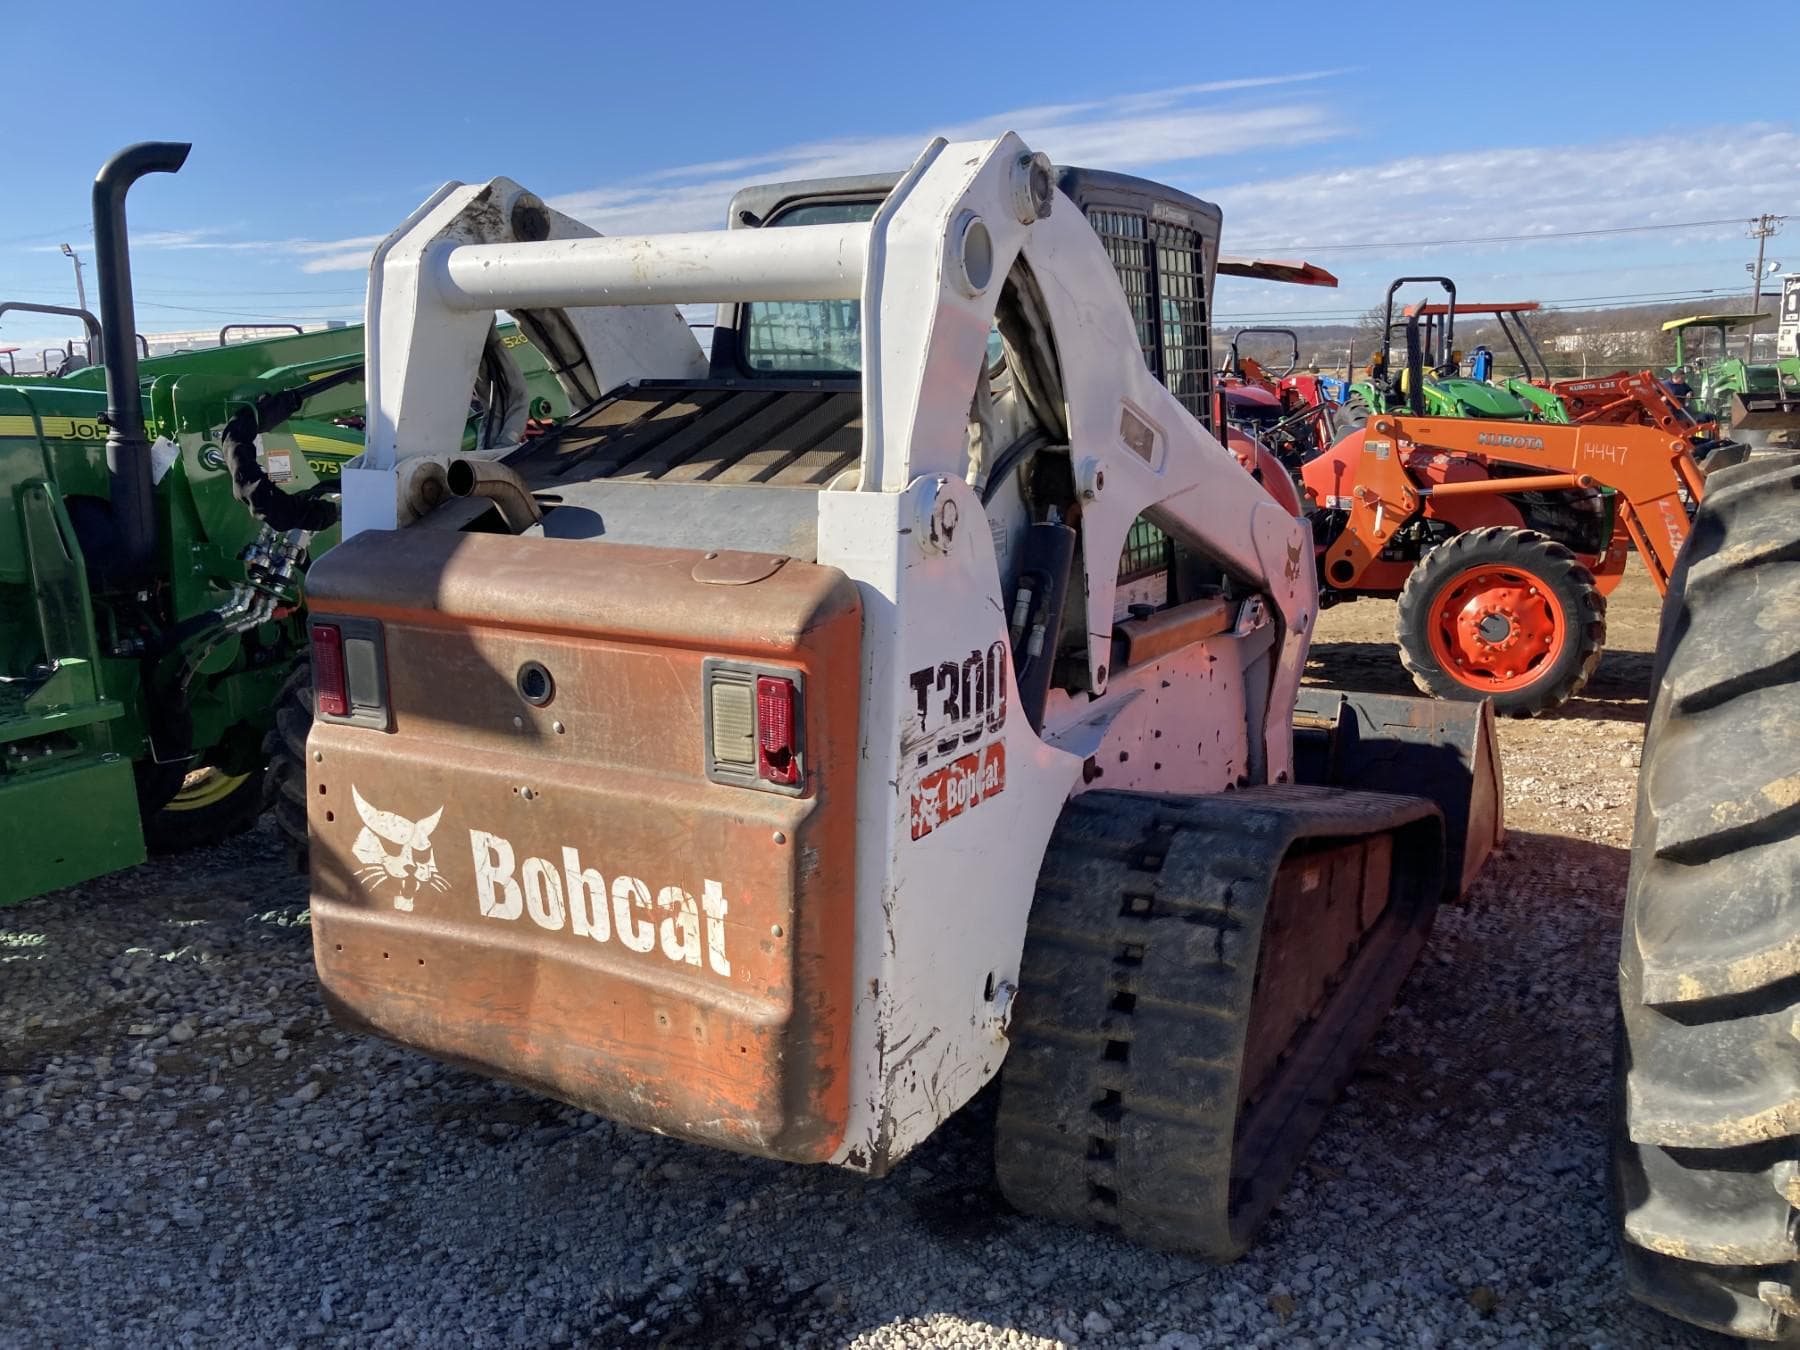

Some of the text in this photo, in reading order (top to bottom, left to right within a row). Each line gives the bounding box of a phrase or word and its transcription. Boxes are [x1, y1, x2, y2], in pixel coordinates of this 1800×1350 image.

[1568, 383, 1596, 392] KUBOTA
[63, 420, 110, 438] JOH
[1478, 432, 1544, 449] KUBOTA
[910, 640, 1008, 769] T300
[469, 828, 731, 977] Bobcat
